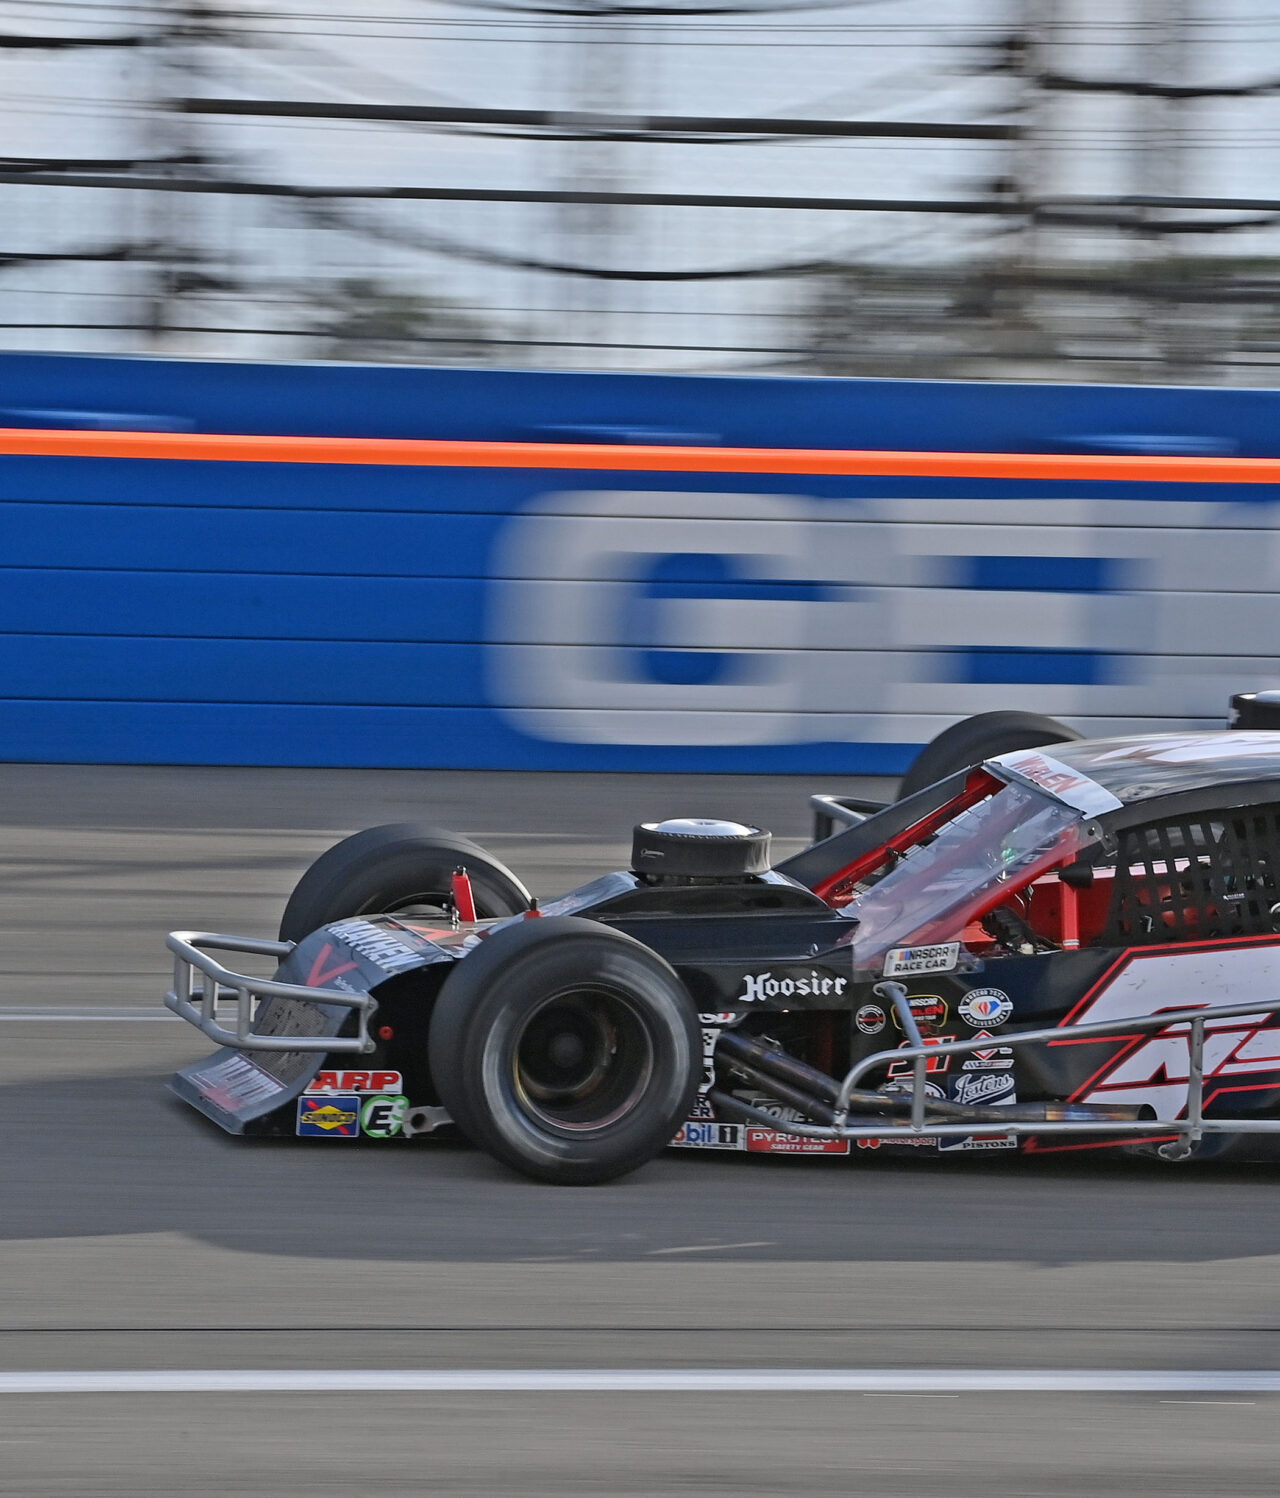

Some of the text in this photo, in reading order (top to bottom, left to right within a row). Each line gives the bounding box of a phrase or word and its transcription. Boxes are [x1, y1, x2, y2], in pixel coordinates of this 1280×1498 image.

[908, 946, 950, 960] NASCAR
[894, 958, 947, 972] RACE CAR
[738, 970, 848, 1003] Hoosier
[308, 1071, 400, 1091] ARP
[673, 1123, 712, 1143] obil
[770, 1143, 802, 1151] SAFETY
[962, 1139, 1016, 1149] PISTONS
